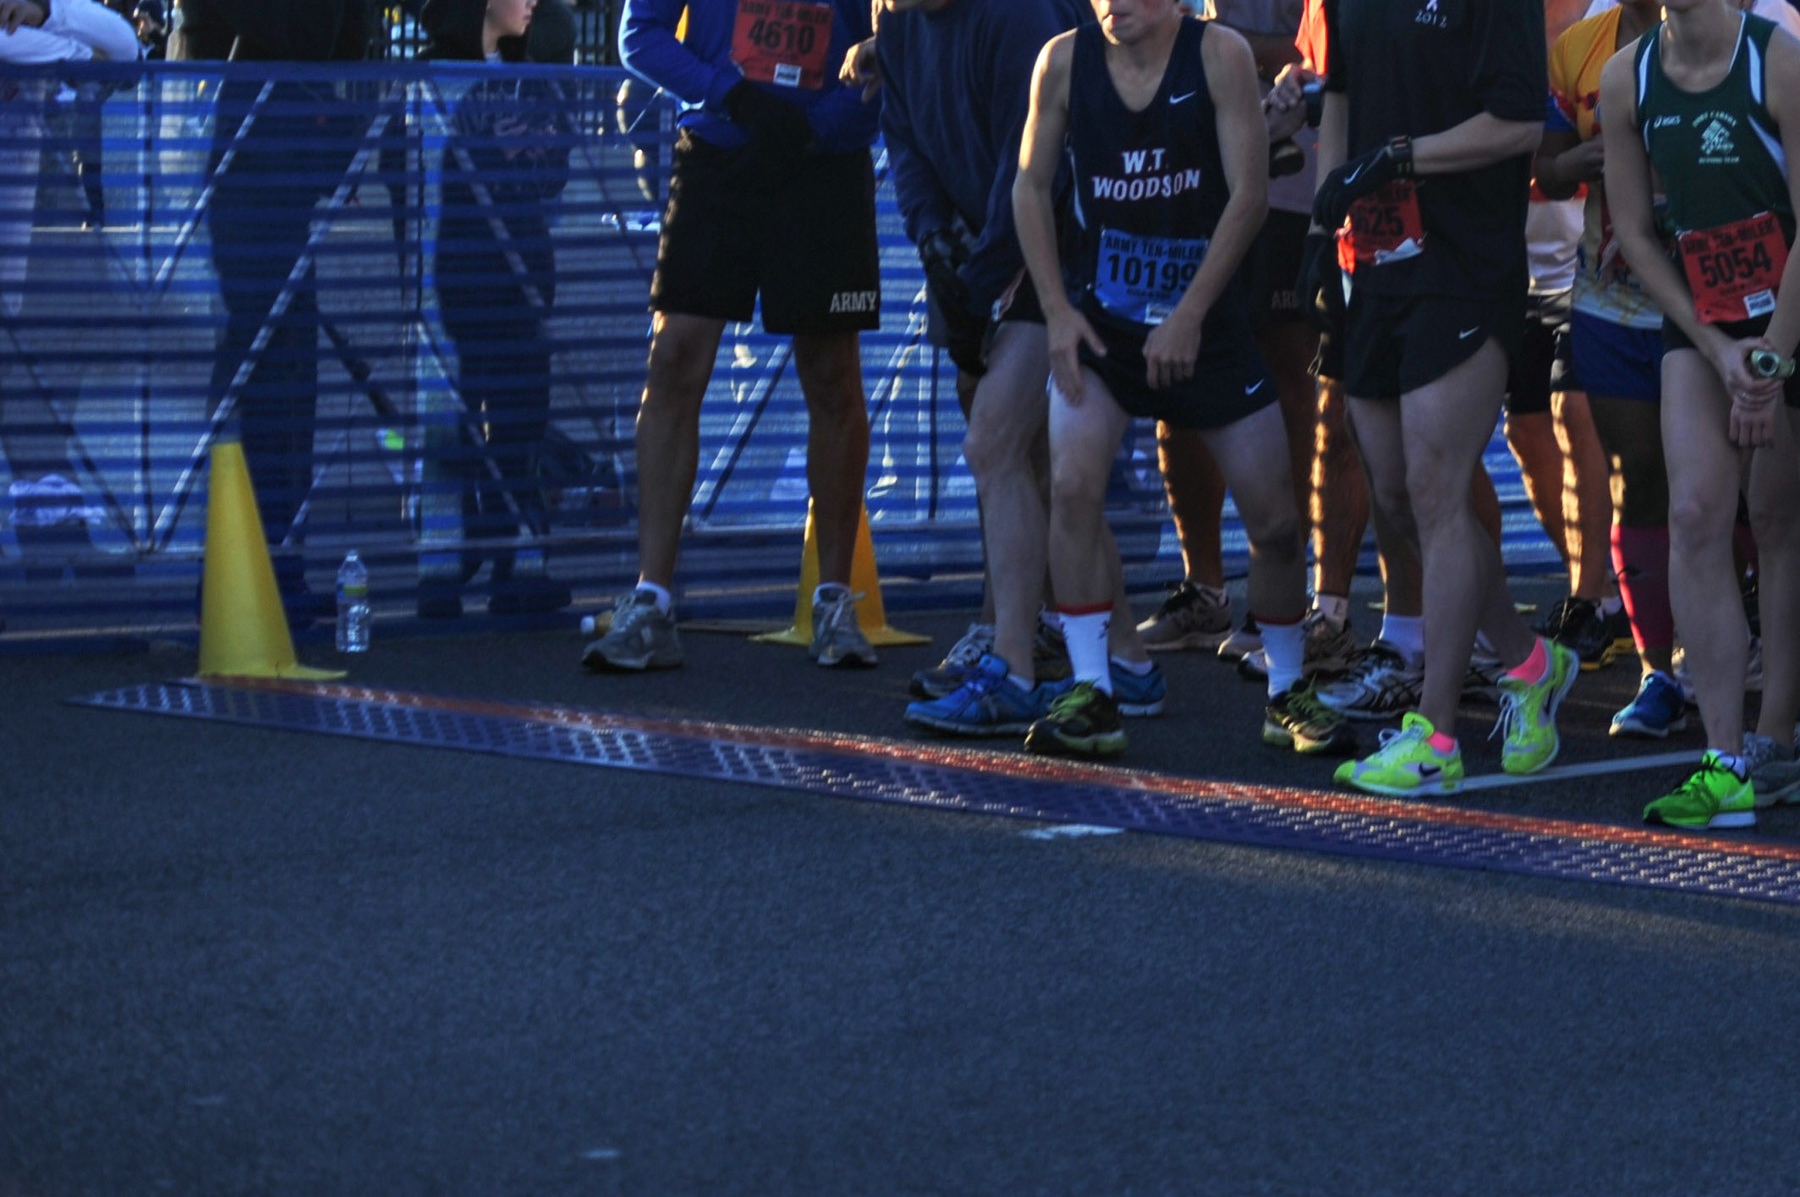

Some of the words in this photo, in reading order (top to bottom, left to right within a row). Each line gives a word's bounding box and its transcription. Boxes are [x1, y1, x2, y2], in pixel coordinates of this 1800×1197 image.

[1414, 9, 1448, 29] 2012
[748, 17, 816, 56] 4610
[1092, 168, 1201, 201] WOODSON
[1698, 241, 1772, 288] 5054
[828, 290, 878, 314] ARMY
